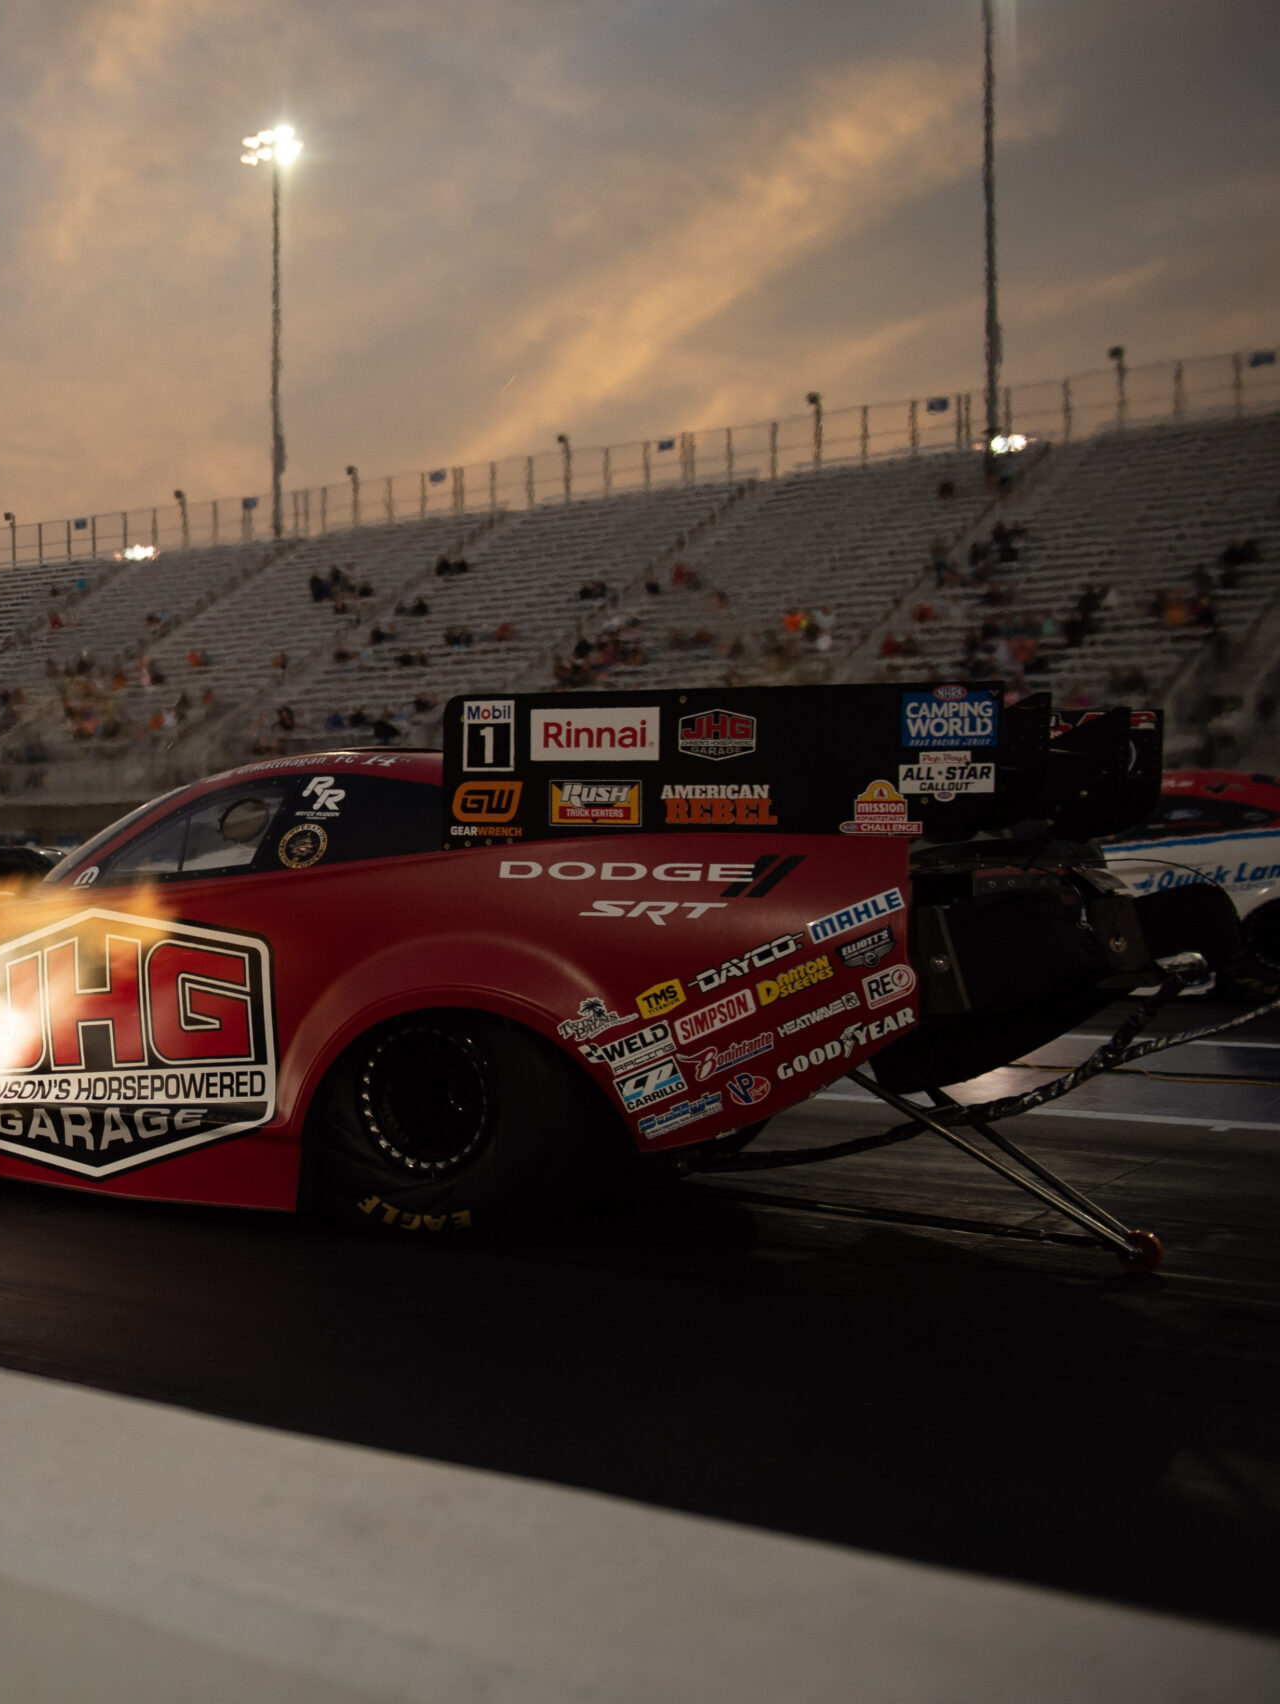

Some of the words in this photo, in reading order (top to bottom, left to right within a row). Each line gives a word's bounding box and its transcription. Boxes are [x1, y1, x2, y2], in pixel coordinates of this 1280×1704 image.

[467, 705, 511, 720] Mobil
[905, 701, 993, 718] CAMPING
[543, 719, 647, 748] Rinnai
[681, 714, 753, 739] JHG
[905, 717, 994, 737] WORLD
[480, 726, 495, 764] 1
[690, 746, 742, 755] GARAGE
[361, 754, 402, 767] 14
[902, 766, 934, 781] ALL
[945, 766, 992, 780] STAR
[560, 782, 632, 808] RUSH
[660, 784, 771, 800] AMERICAN
[920, 781, 970, 791] CALLOUT
[566, 808, 590, 817] TRUCK
[591, 808, 624, 817] CENTERS
[665, 798, 778, 825] REBEL
[450, 826, 523, 837] GEARWRENCH
[860, 824, 918, 832] CHALLENGE
[498, 861, 756, 883] DODGE
[1158, 866, 1230, 891] Quick
[1234, 861, 1280, 882] Lan
[578, 900, 729, 926] SRT
[811, 890, 902, 941] MAHLE
[841, 930, 889, 956] ELLIOTT'S
[693, 934, 798, 993] DAYCO
[755, 954, 830, 1007] DARTON
[780, 967, 835, 998] SLEEVES
[642, 985, 677, 1009] TMS
[680, 994, 749, 1041] SIMPSON
[777, 999, 847, 1038] HEATWAVE
[602, 1023, 670, 1062] WELD
[777, 1007, 916, 1081] GOODYEAR
[613, 1043, 675, 1074] RACING
[75, 1071, 265, 1101] HORSEPOWERED
[626, 1082, 685, 1111] CARRILLO
[727, 1073, 754, 1103] VP
